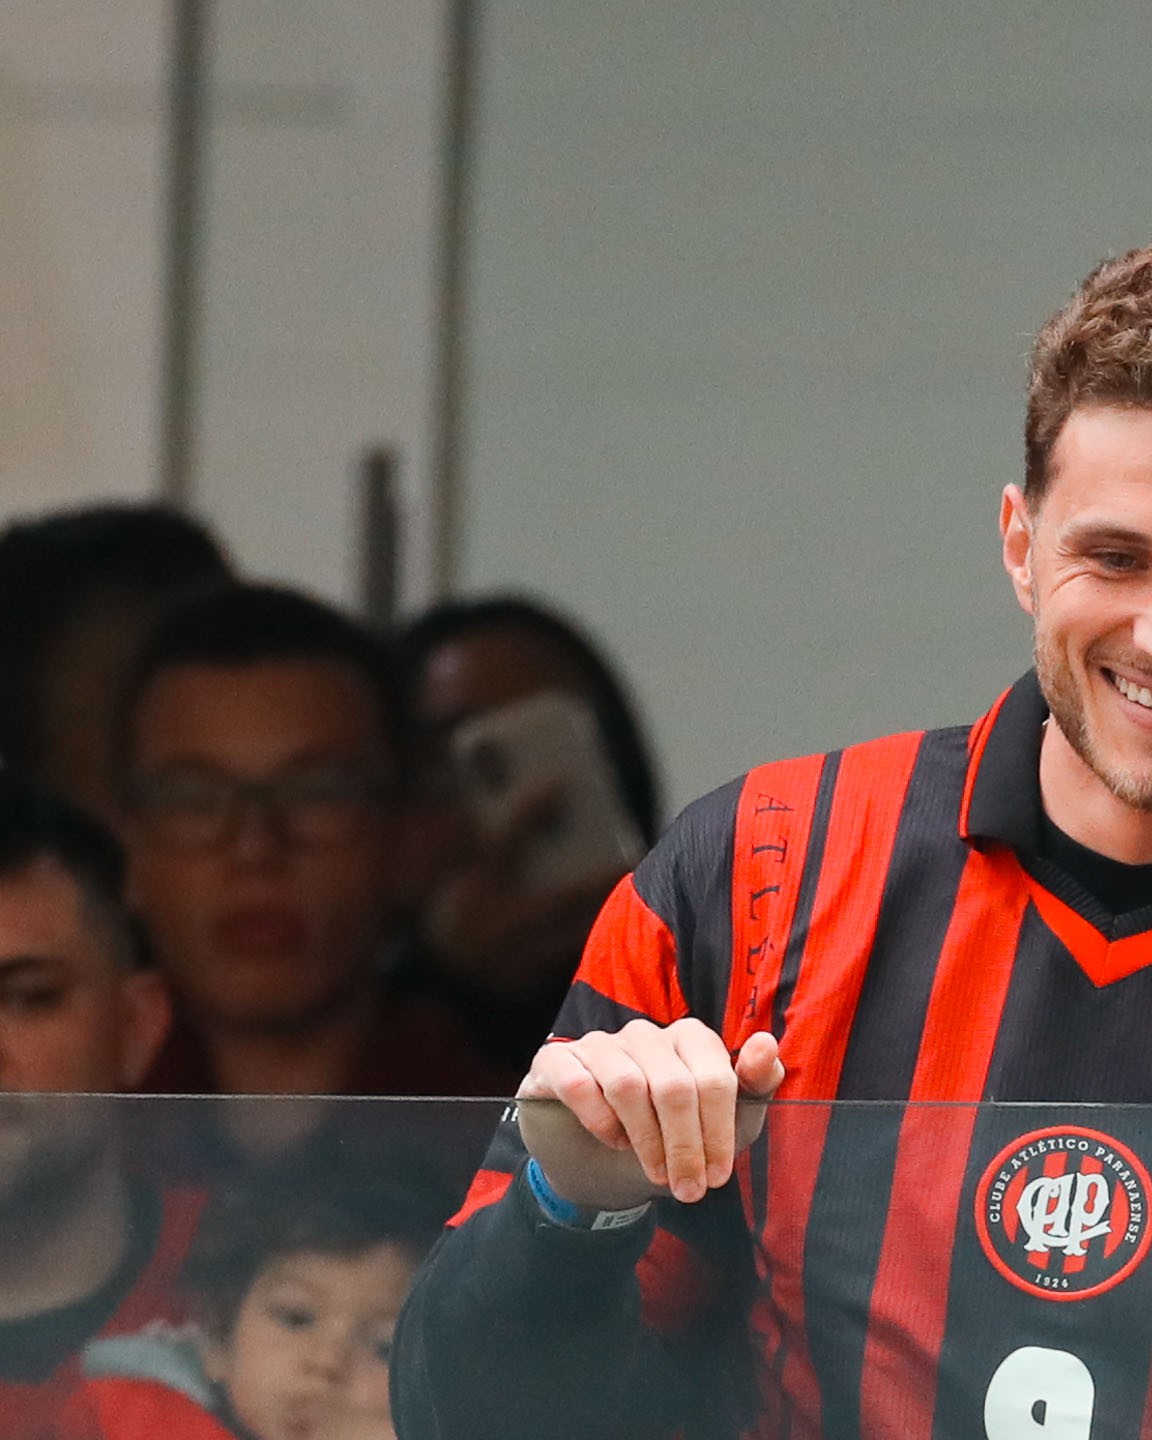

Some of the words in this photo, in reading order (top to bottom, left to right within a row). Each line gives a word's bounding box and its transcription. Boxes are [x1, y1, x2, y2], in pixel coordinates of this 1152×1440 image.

[990, 1171, 1011, 1223] CLUBE
[1011, 1138, 1089, 1170] ATLÉTICO
[1095, 1146, 1142, 1243] PARANAENSE
[1035, 1274, 1069, 1288] 1924
